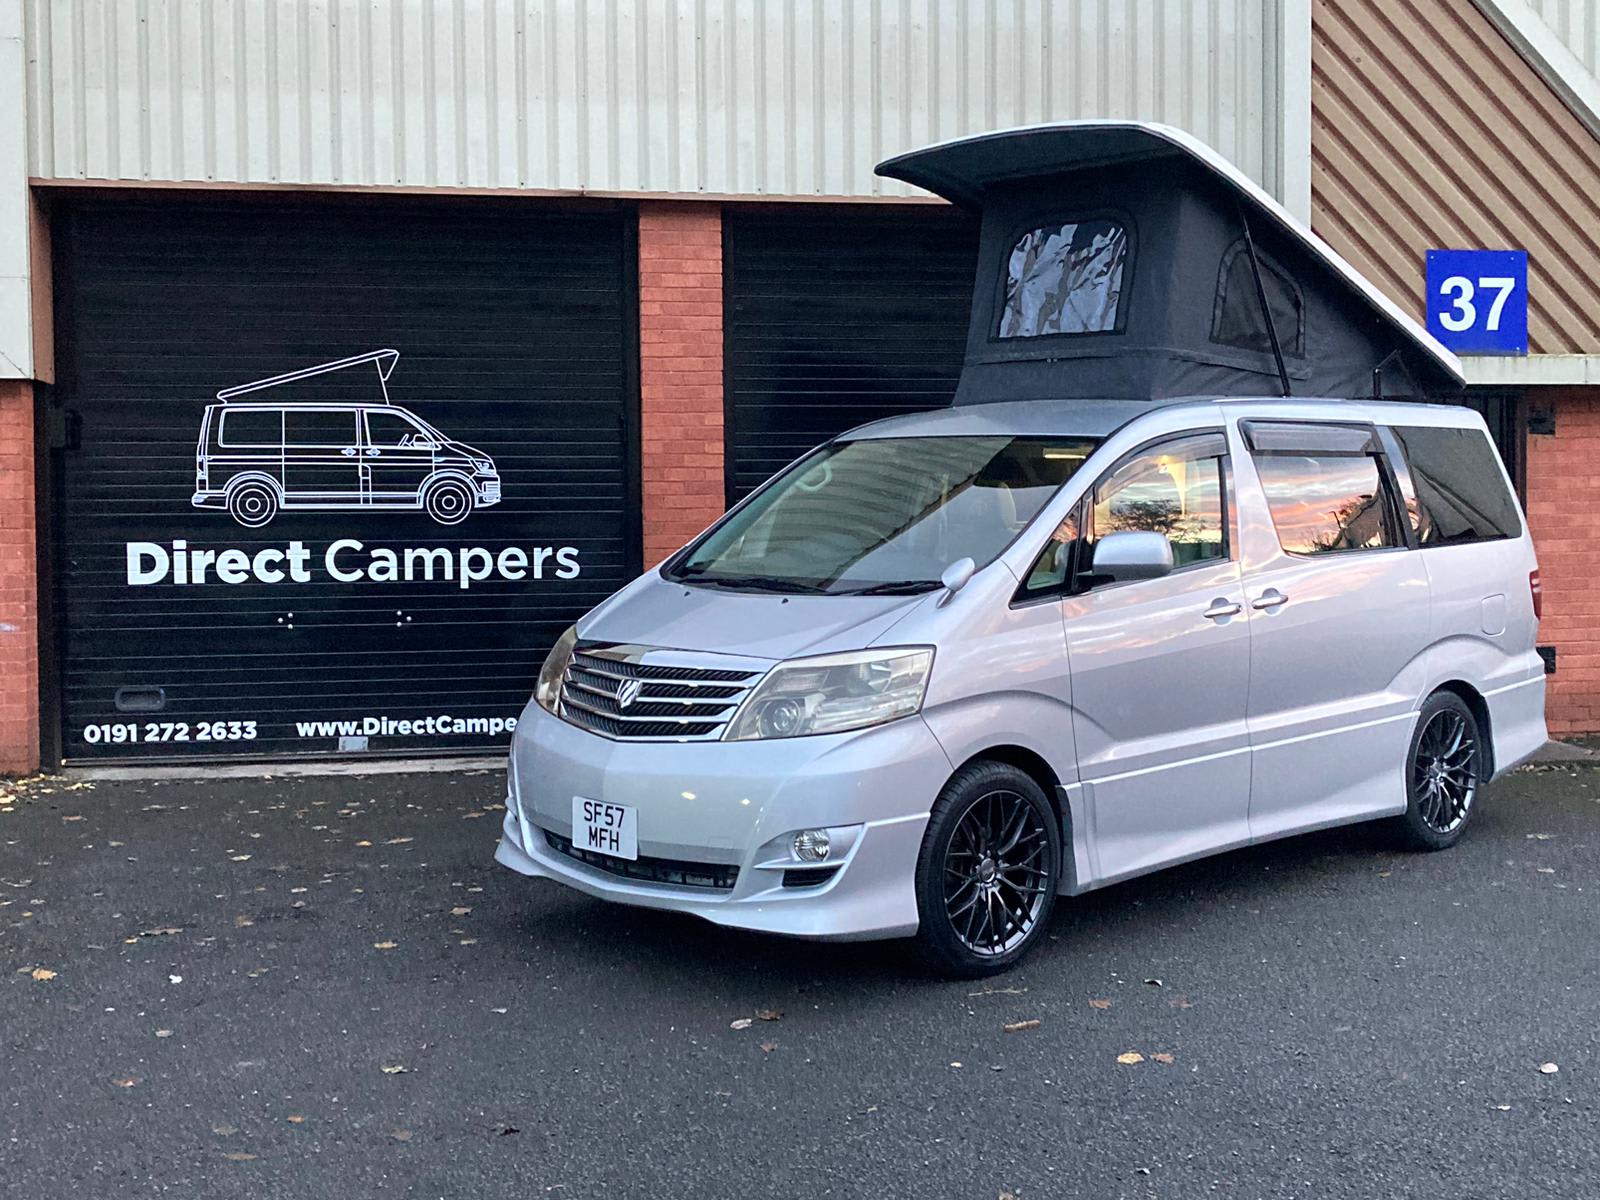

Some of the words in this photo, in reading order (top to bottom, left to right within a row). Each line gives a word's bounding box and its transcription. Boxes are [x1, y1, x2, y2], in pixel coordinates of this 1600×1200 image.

[1439, 276, 1516, 332] 37
[126, 540, 311, 585] Direct
[325, 538, 581, 589] Campers
[84, 724, 137, 743] 0191
[144, 722, 190, 742] 272
[196, 721, 257, 740] 2633
[584, 801, 625, 829] SF57
[588, 826, 619, 852] MFH
